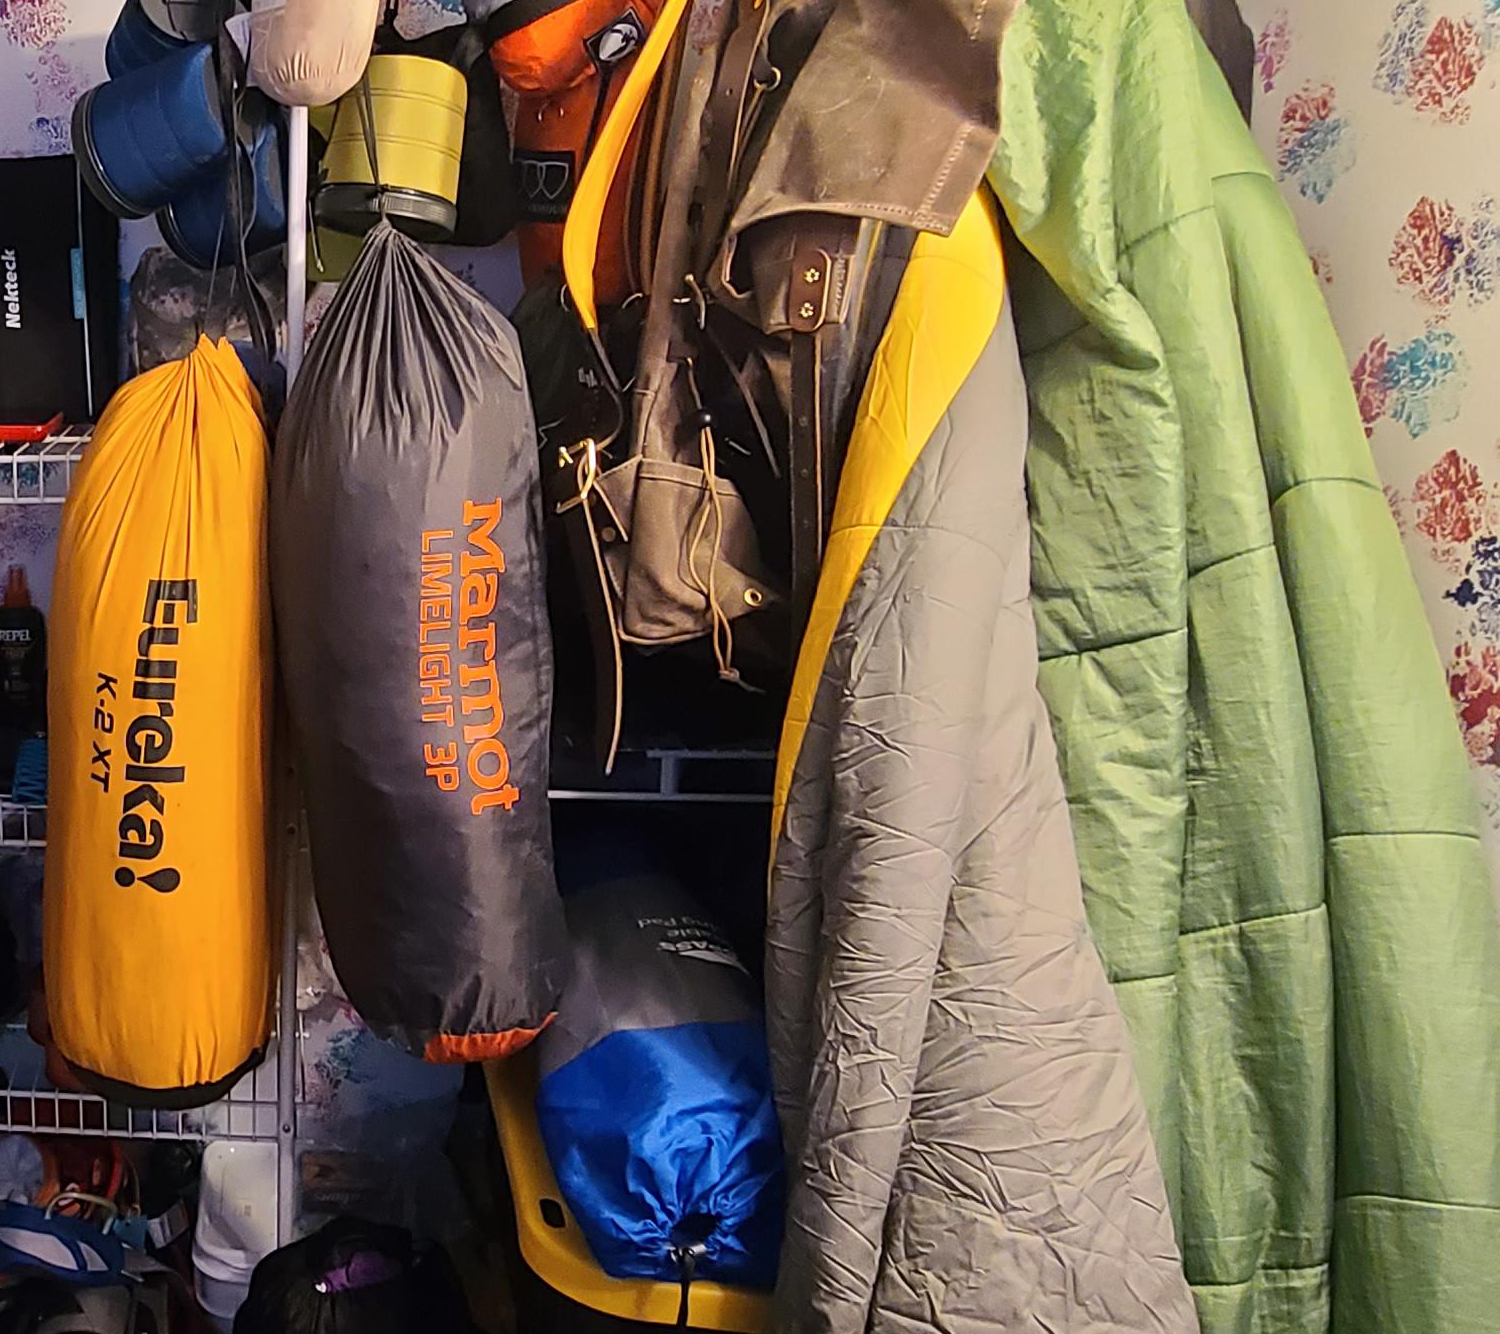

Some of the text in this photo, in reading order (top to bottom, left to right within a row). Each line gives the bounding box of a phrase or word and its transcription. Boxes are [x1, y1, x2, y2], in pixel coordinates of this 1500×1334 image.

[1, 248, 21, 328] Nekteck
[91, 671, 118, 793] K-2 XT
[114, 578, 198, 893] Eureka!
[419, 529, 460, 791] LIMELIGHT 3P
[458, 497, 520, 815] Marmot
